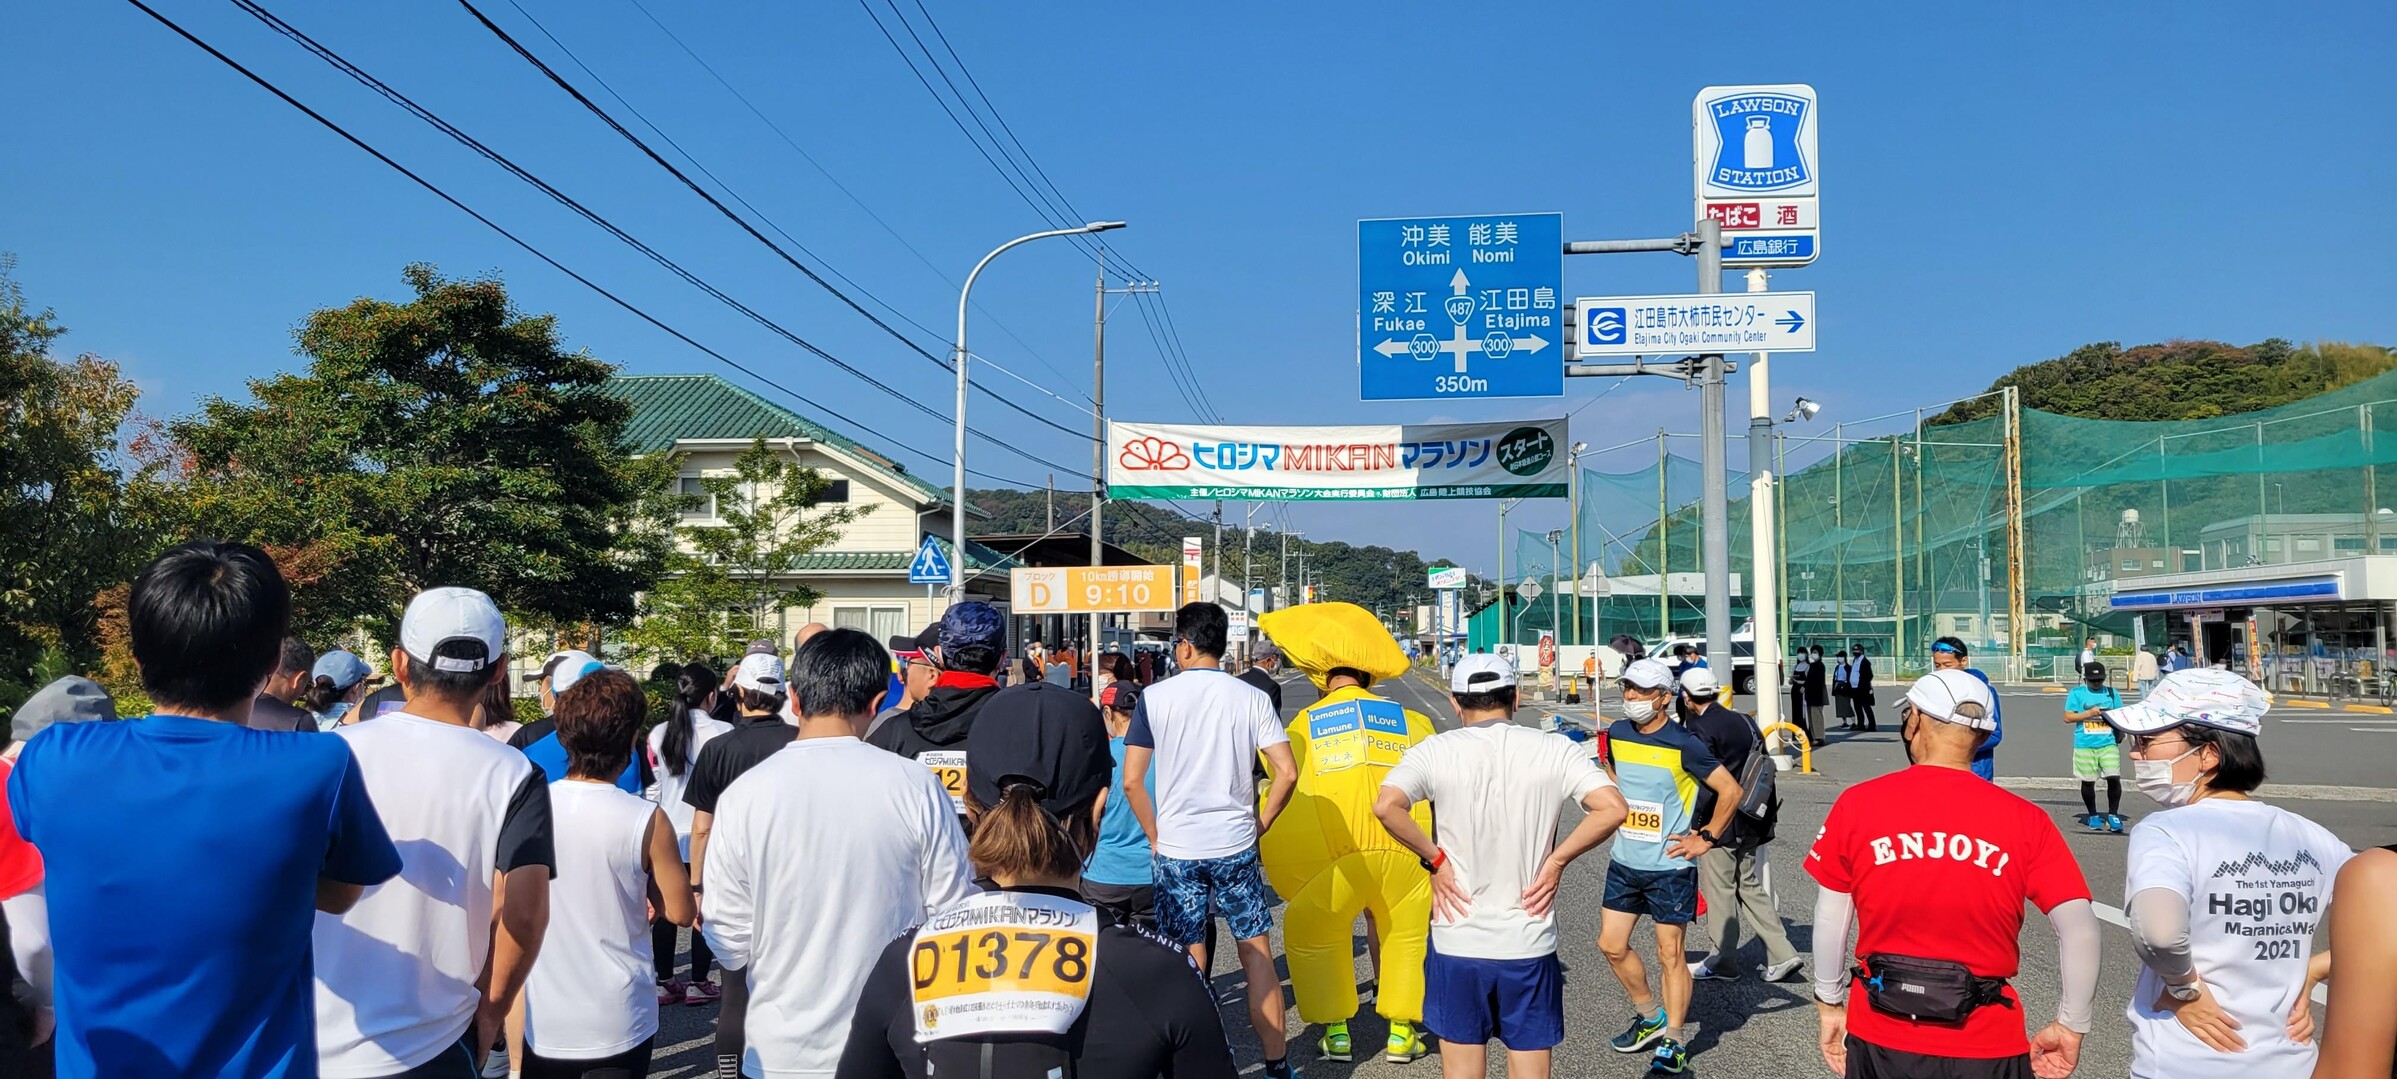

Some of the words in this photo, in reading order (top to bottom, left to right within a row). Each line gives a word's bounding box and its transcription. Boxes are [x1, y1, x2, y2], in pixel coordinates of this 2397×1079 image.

[1716, 98, 1800, 118] LAWSON
[1718, 166, 1800, 185] STATION
[1708, 205, 1758, 226] たばこ
[1776, 205, 1798, 225] 酒
[1401, 224, 1450, 247] 沖美
[1468, 222, 1518, 245] 能美
[1737, 239, 1799, 255] 広島銀行
[1403, 250, 1450, 266] Okimi
[1472, 248, 1514, 263] Nomi
[1372, 292, 1427, 314] 深江
[1480, 286, 1556, 311] 江田島
[1450, 302, 1471, 316] 487
[1634, 304, 1766, 329] 江田島市大柿市民センター
[1374, 317, 1426, 332] Fukae
[1485, 313, 1551, 330] Etajima
[1413, 340, 1436, 354] 300
[1487, 337, 1509, 352] 300
[1634, 332, 1662, 347] Etajima
[1663, 331, 1677, 346] City
[1679, 331, 1700, 346] Ogaki
[1701, 330, 1742, 345] Community
[1743, 329, 1767, 343] Center
[1435, 375, 1488, 393] 350m
[1193, 439, 1491, 471] ヒロシマMIKANマラソン
[1500, 431, 1549, 463] スタート
[1024, 572, 1056, 581] ブロック
[1081, 570, 1154, 582] 10km誘導開始
[1030, 583, 1051, 607] D
[1085, 584, 1150, 606] 9:10
[1310, 705, 1355, 721] Lemonade
[1367, 714, 1398, 727] #Love
[1317, 722, 1353, 736] Lamune
[1315, 733, 1360, 750] レモネード
[1367, 736, 1407, 752] Peace
[1321, 751, 1353, 765] ラムネ
[1870, 831, 2009, 877] ENJOY!
[2235, 880, 2254, 889] The
[2255, 880, 2268, 889] 1st
[2208, 893, 2273, 922] Hagi
[2254, 939, 2301, 961] 2021
[914, 931, 1088, 990] D1378
